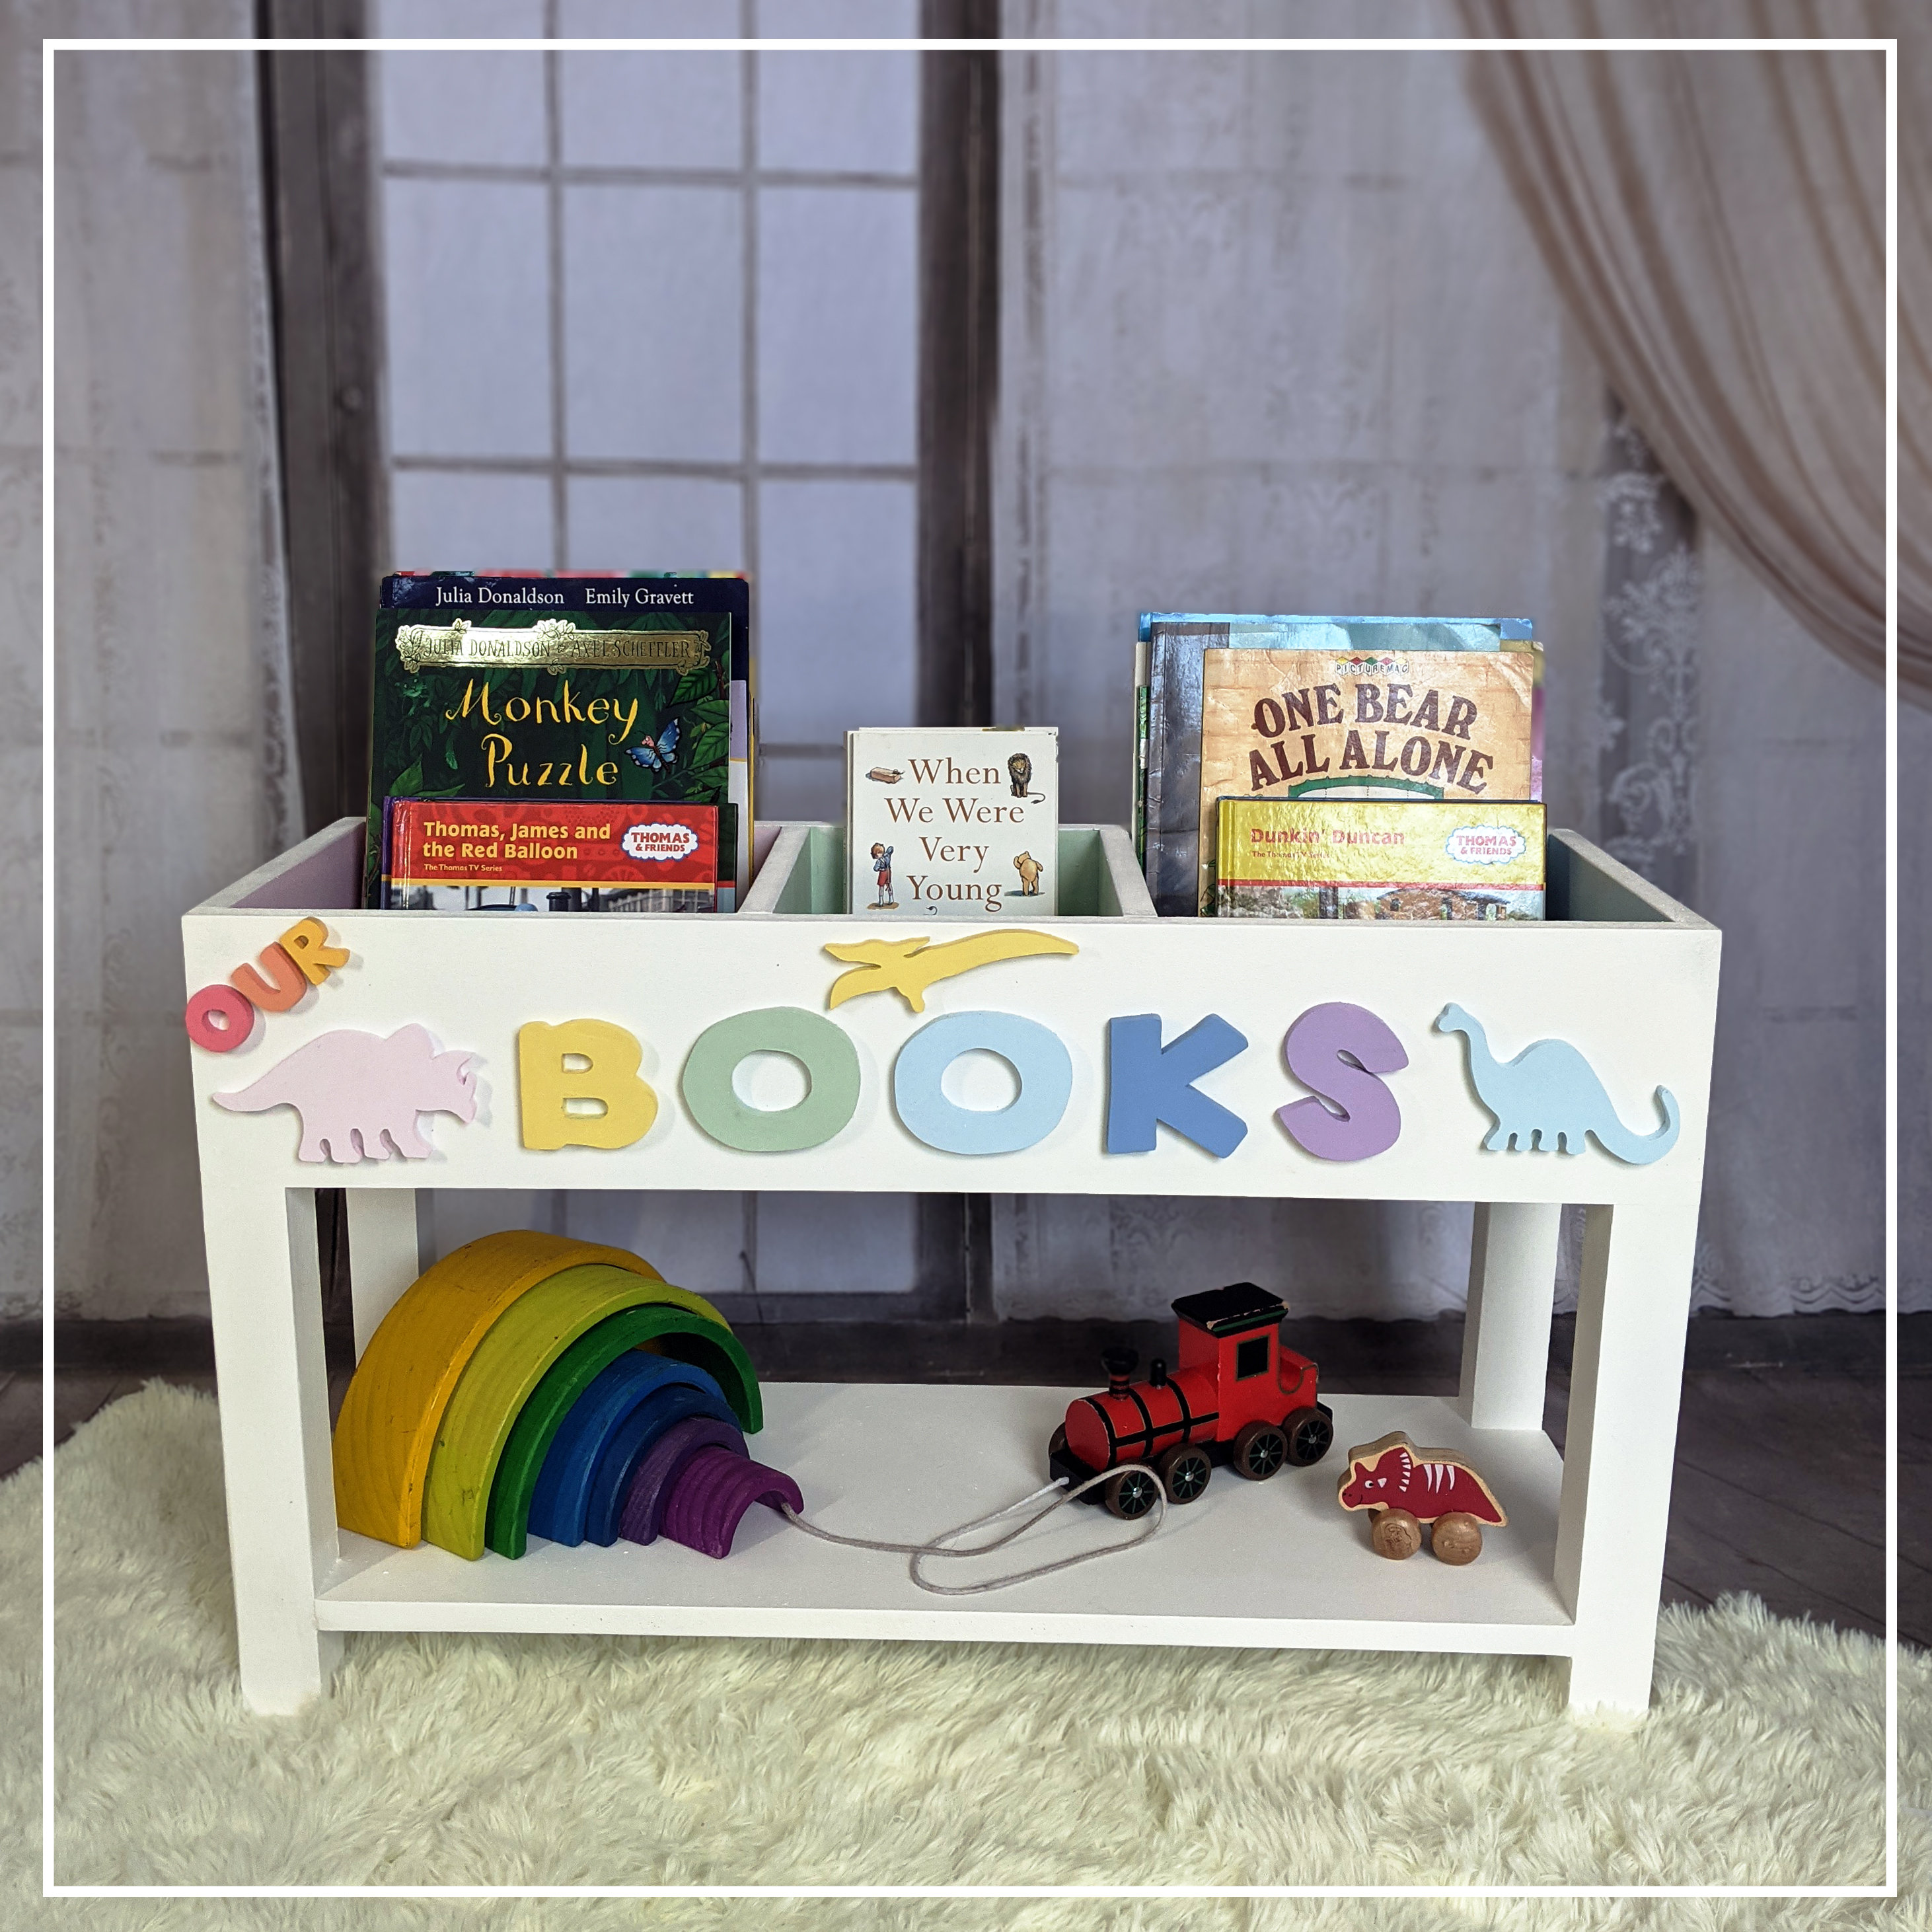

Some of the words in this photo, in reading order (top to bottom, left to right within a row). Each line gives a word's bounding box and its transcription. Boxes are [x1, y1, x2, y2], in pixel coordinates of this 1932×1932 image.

[435, 587, 472, 606] Julia
[478, 587, 564, 604] Donaldson
[585, 588, 630, 608] Emily
[635, 589, 694, 605] Gravett
[424, 638, 464, 657] JULIA
[468, 640, 550, 658] DONALDSON
[570, 640, 610, 659] AXEL
[1336, 663, 1408, 673] PICTUREMAC
[445, 679, 638, 745] Monkey
[1251, 683, 1344, 739] ONE
[1355, 684, 1477, 741] BEAR
[481, 733, 618, 788] Puzzle
[908, 757, 1001, 784] When
[1249, 734, 1330, 792] ALL
[1339, 730, 1494, 794] ALONE
[884, 798, 934, 823] We
[942, 798, 1024, 823] Were
[424, 821, 505, 841] Thomas,
[510, 823, 569, 841] James
[574, 823, 611, 839] and
[631, 832, 690, 844] THOMAS
[1251, 828, 1325, 844] Dunkin'
[1332, 829, 1405, 844] Duncan
[1456, 835, 1516, 846] THOMAS
[423, 841, 455, 858] the
[462, 842, 498, 858] Red
[505, 843, 577, 859] Balloon
[918, 836, 989, 873] Very
[1470, 846, 1512, 856] FRIENDS
[907, 875, 1002, 912] Young
[185, 916, 351, 1053] OUR
[518, 1001, 1409, 1162] BOOKS
